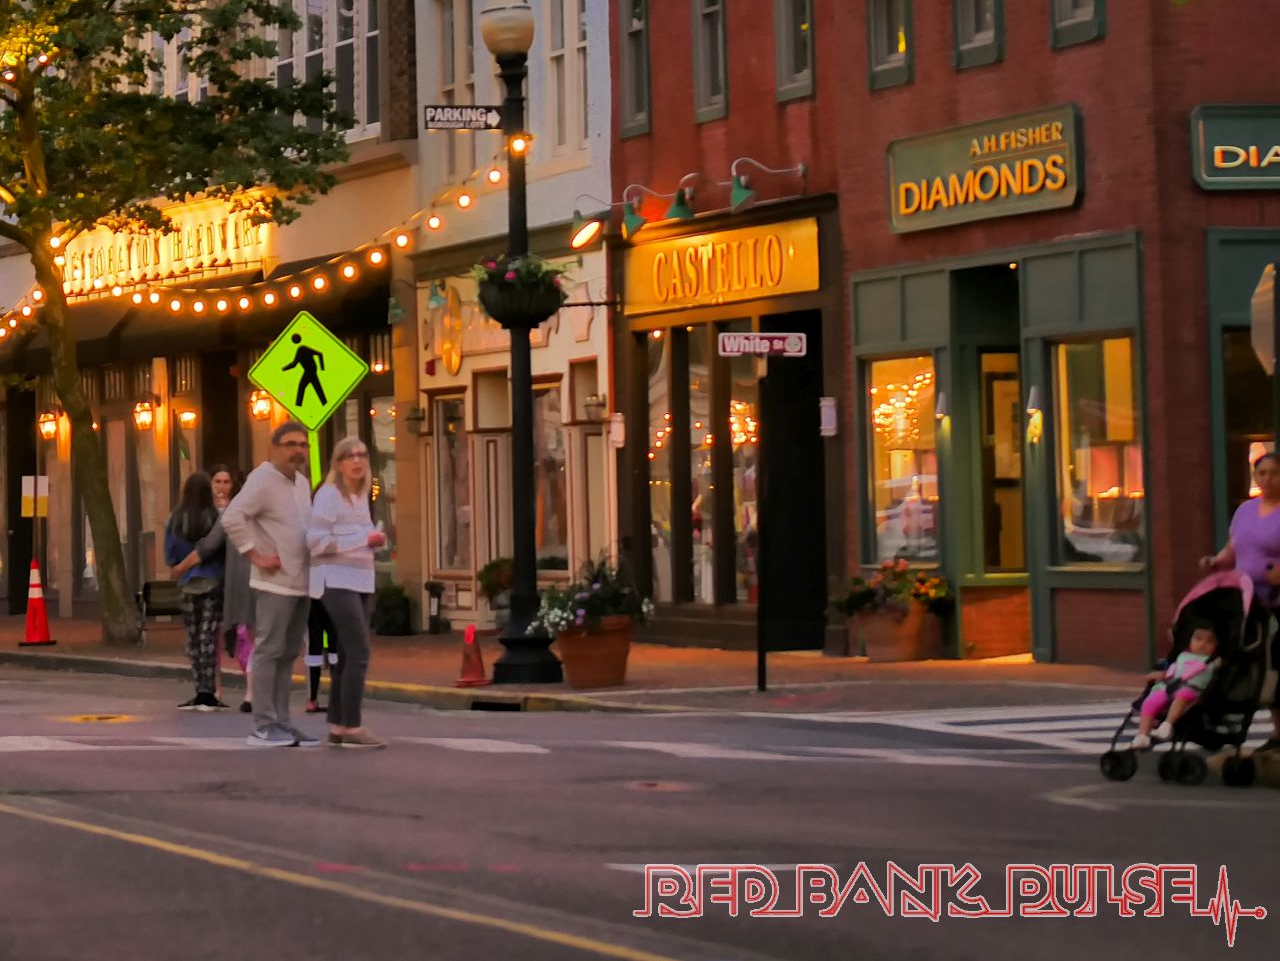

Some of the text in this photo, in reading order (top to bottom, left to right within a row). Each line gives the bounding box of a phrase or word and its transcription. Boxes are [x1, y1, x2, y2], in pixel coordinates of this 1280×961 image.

[425, 107, 487, 121] PARKING
[898, 154, 1068, 217] DIAMONDS
[652, 234, 784, 303] CASTELLO
[723, 336, 771, 353] White
